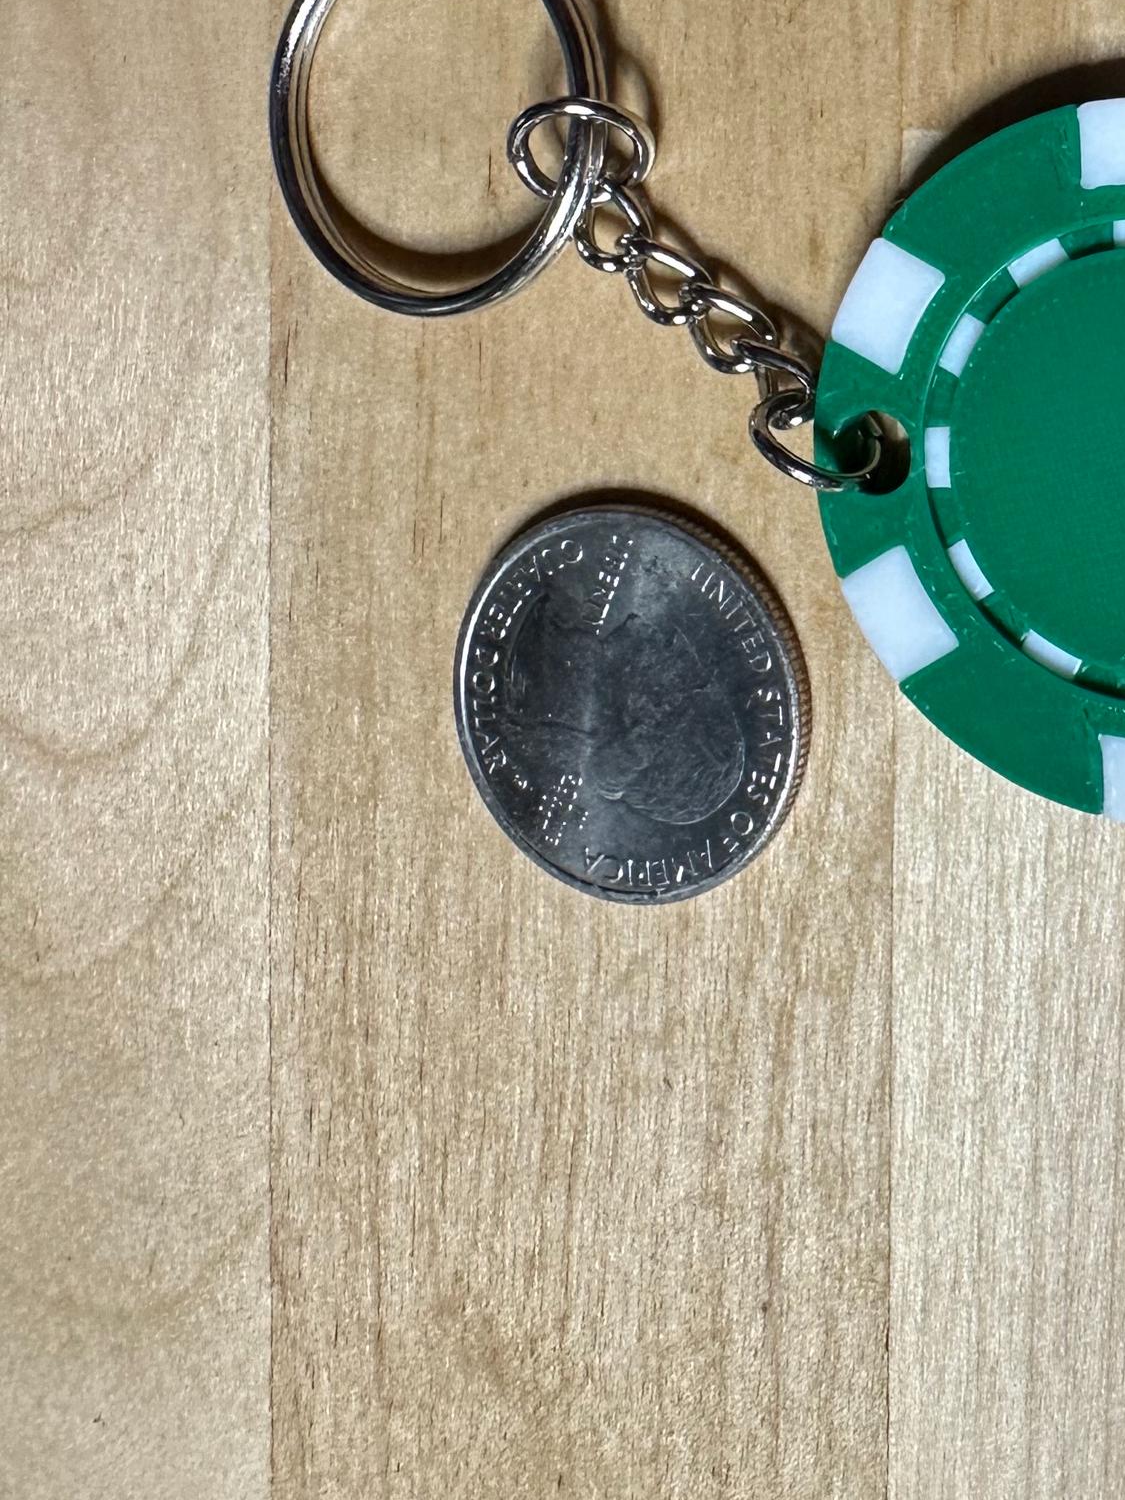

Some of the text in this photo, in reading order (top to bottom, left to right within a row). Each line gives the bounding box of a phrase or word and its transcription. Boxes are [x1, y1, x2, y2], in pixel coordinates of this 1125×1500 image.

[690, 562, 773, 673] UNITED
[746, 688, 783, 806] STATES
[584, 837, 714, 888] AMERICA
